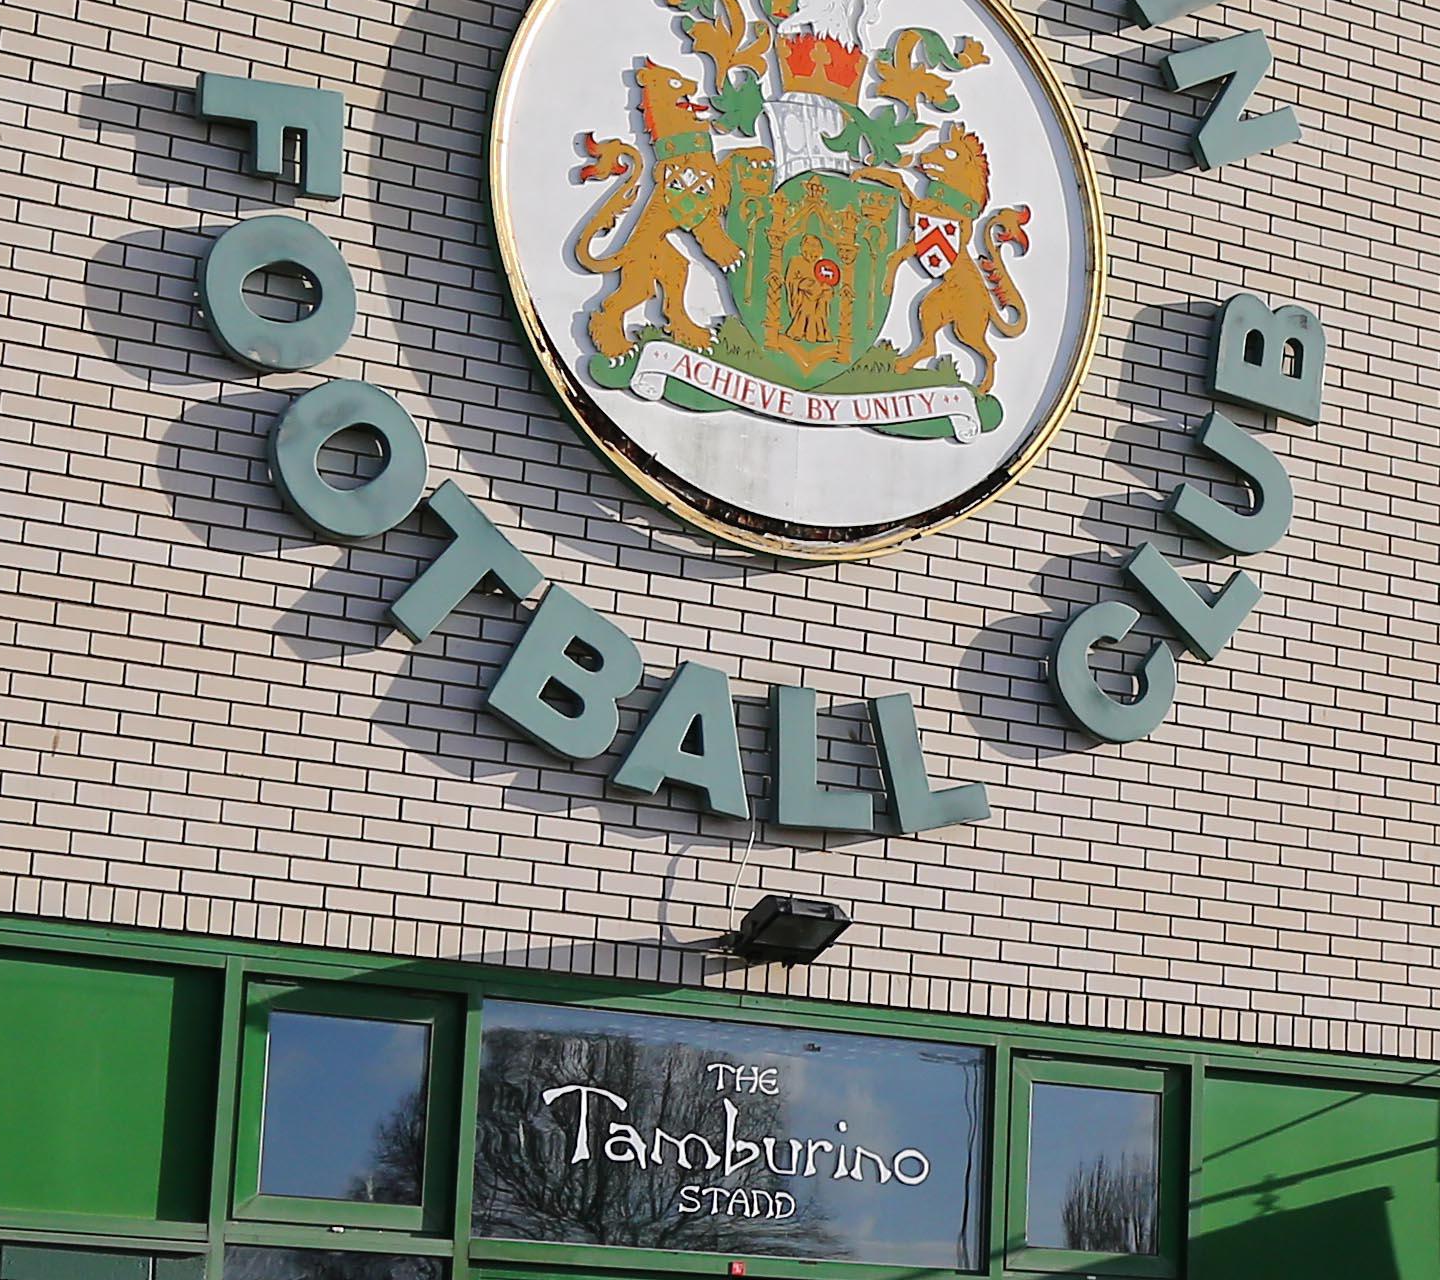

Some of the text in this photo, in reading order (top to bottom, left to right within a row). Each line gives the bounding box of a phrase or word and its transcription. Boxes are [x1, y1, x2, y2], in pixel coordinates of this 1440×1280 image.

[672, 354, 936, 421] ACHIEVE BY UNITY
[197, 70, 1327, 836] FOOTBALL CLUB
[707, 1063, 779, 1095] THE
[542, 1085, 930, 1185] Tamburino
[678, 1185, 797, 1220] STAND
